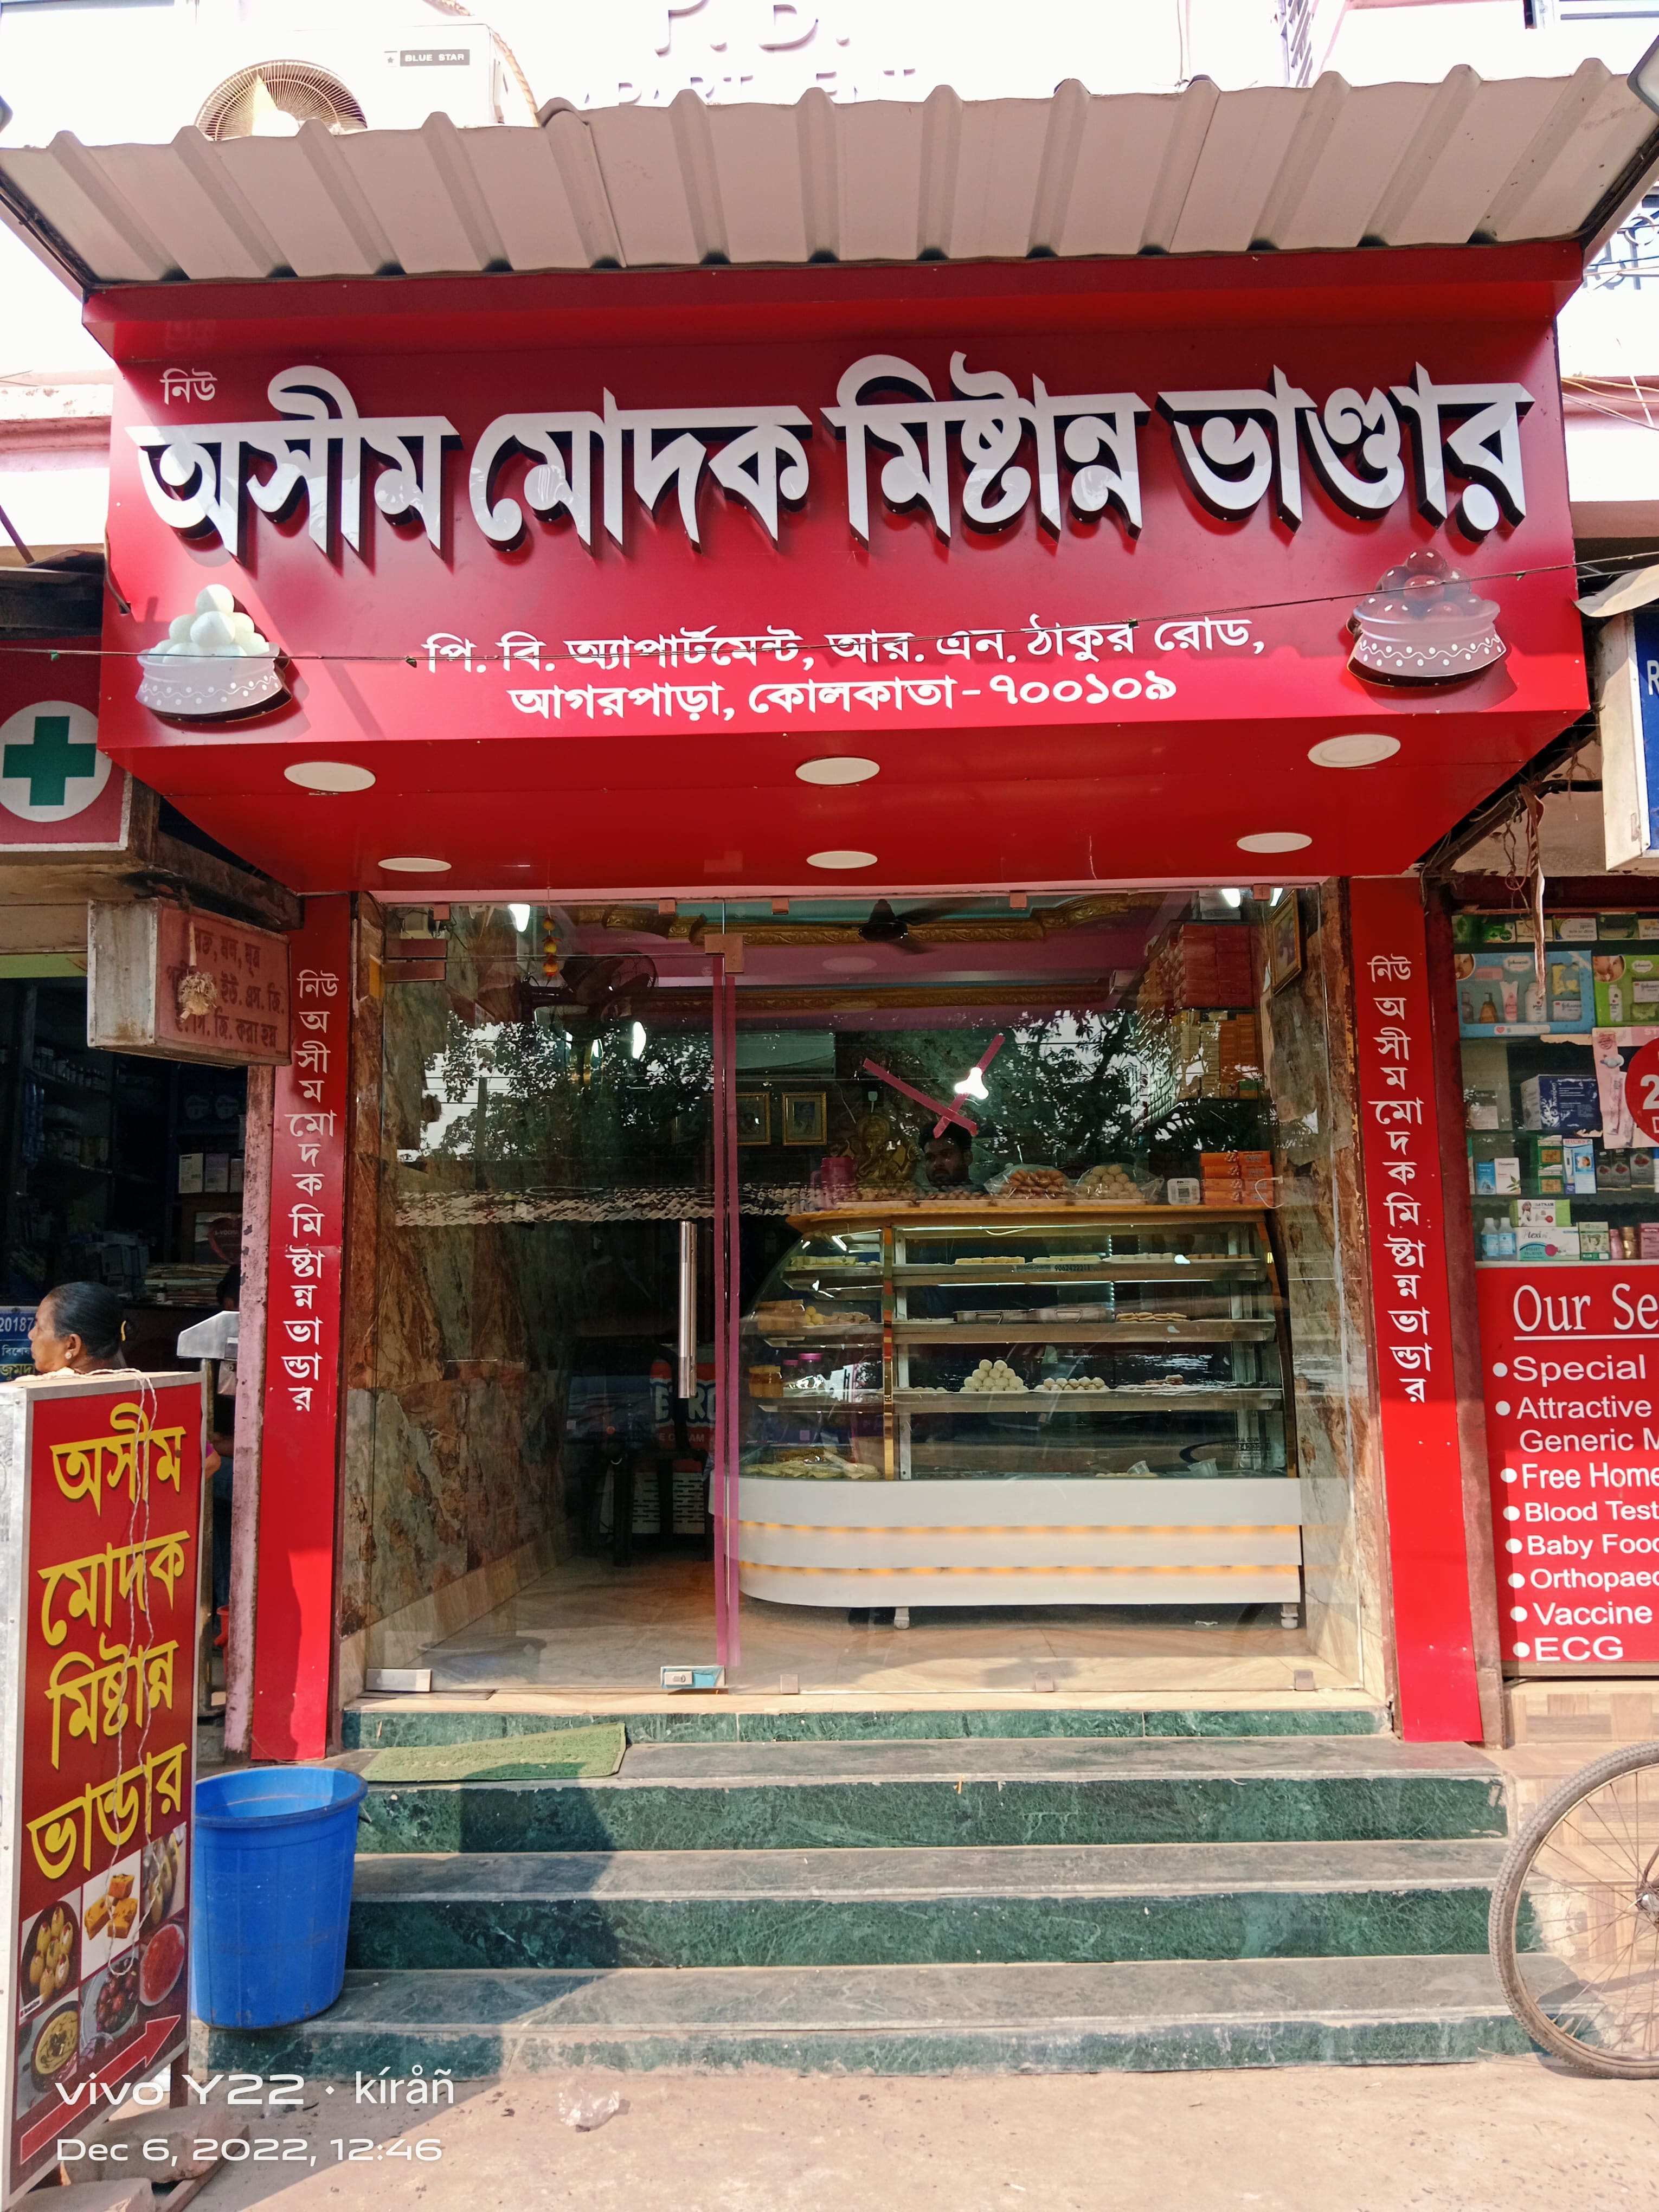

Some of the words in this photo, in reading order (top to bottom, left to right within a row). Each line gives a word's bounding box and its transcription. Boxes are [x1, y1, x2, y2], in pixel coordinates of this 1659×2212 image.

[405, 54, 433, 62] BLUE
[160, 368, 217, 404] নিউ
[125, 365, 460, 556] অসীম
[469, 387, 812, 545] মোদক
[819, 351, 1151, 541] মিষ্টান্ন
[422, 633, 486, 673] পি.
[496, 631, 556, 672] বি.
[825, 629, 925, 663] আর.
[936, 629, 1016, 663] এন.
[1021, 613, 1139, 662] ঠাকুর
[1154, 616, 1264, 655] রোড,
[506, 680, 735, 721] আগরপাড়া,
[1367, 953, 1412, 983] নিউ
[297, 969, 339, 999] নিউ
[1513, 1284, 1591, 1332] Our
[1612, 1283, 1659, 1330] Se
[1513, 1354, 1646, 1388] Special
[1516, 1395, 1652, 1420] Attractive
[1520, 1428, 1635, 1453] Generic
[49, 1403, 187, 1517] অসীম
[1522, 1463, 1581, 1490] Free
[1525, 1501, 1598, 1522] Blood
[1605, 1500, 1659, 1521] Test
[1527, 1535, 1594, 1560] Baby
[37, 1530, 190, 1646] মোদক
[1533, 1601, 1652, 1626] Vaccine
[1534, 1636, 1624, 1662] ECG
[44, 1632, 179, 1770] মিষ্টান্ন
